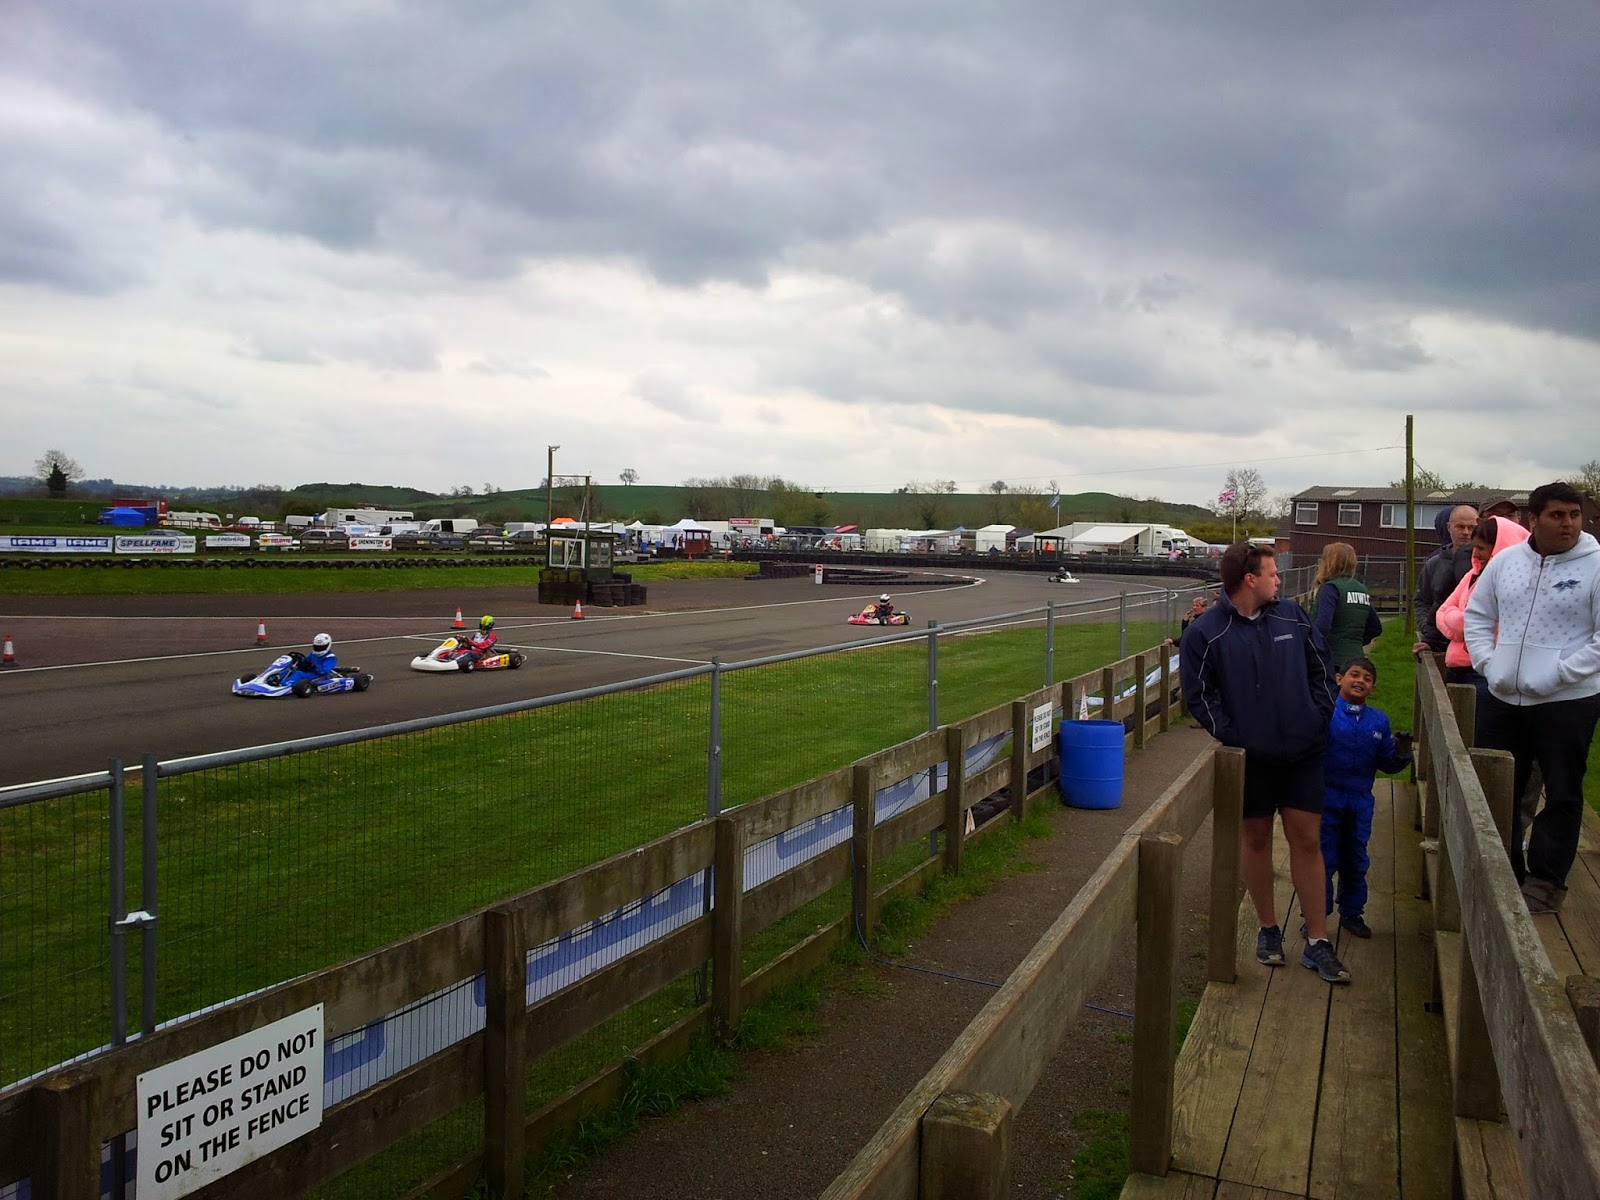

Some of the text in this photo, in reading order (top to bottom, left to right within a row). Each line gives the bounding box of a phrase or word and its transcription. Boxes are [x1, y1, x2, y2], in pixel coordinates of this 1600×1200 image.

[120, 539, 176, 547] SPELLFAME
[147, 1028, 317, 1119] PLEASE DO NOT
[160, 1065, 307, 1148] SIT OR STAND
[154, 1093, 310, 1184] ON THE FENCE
